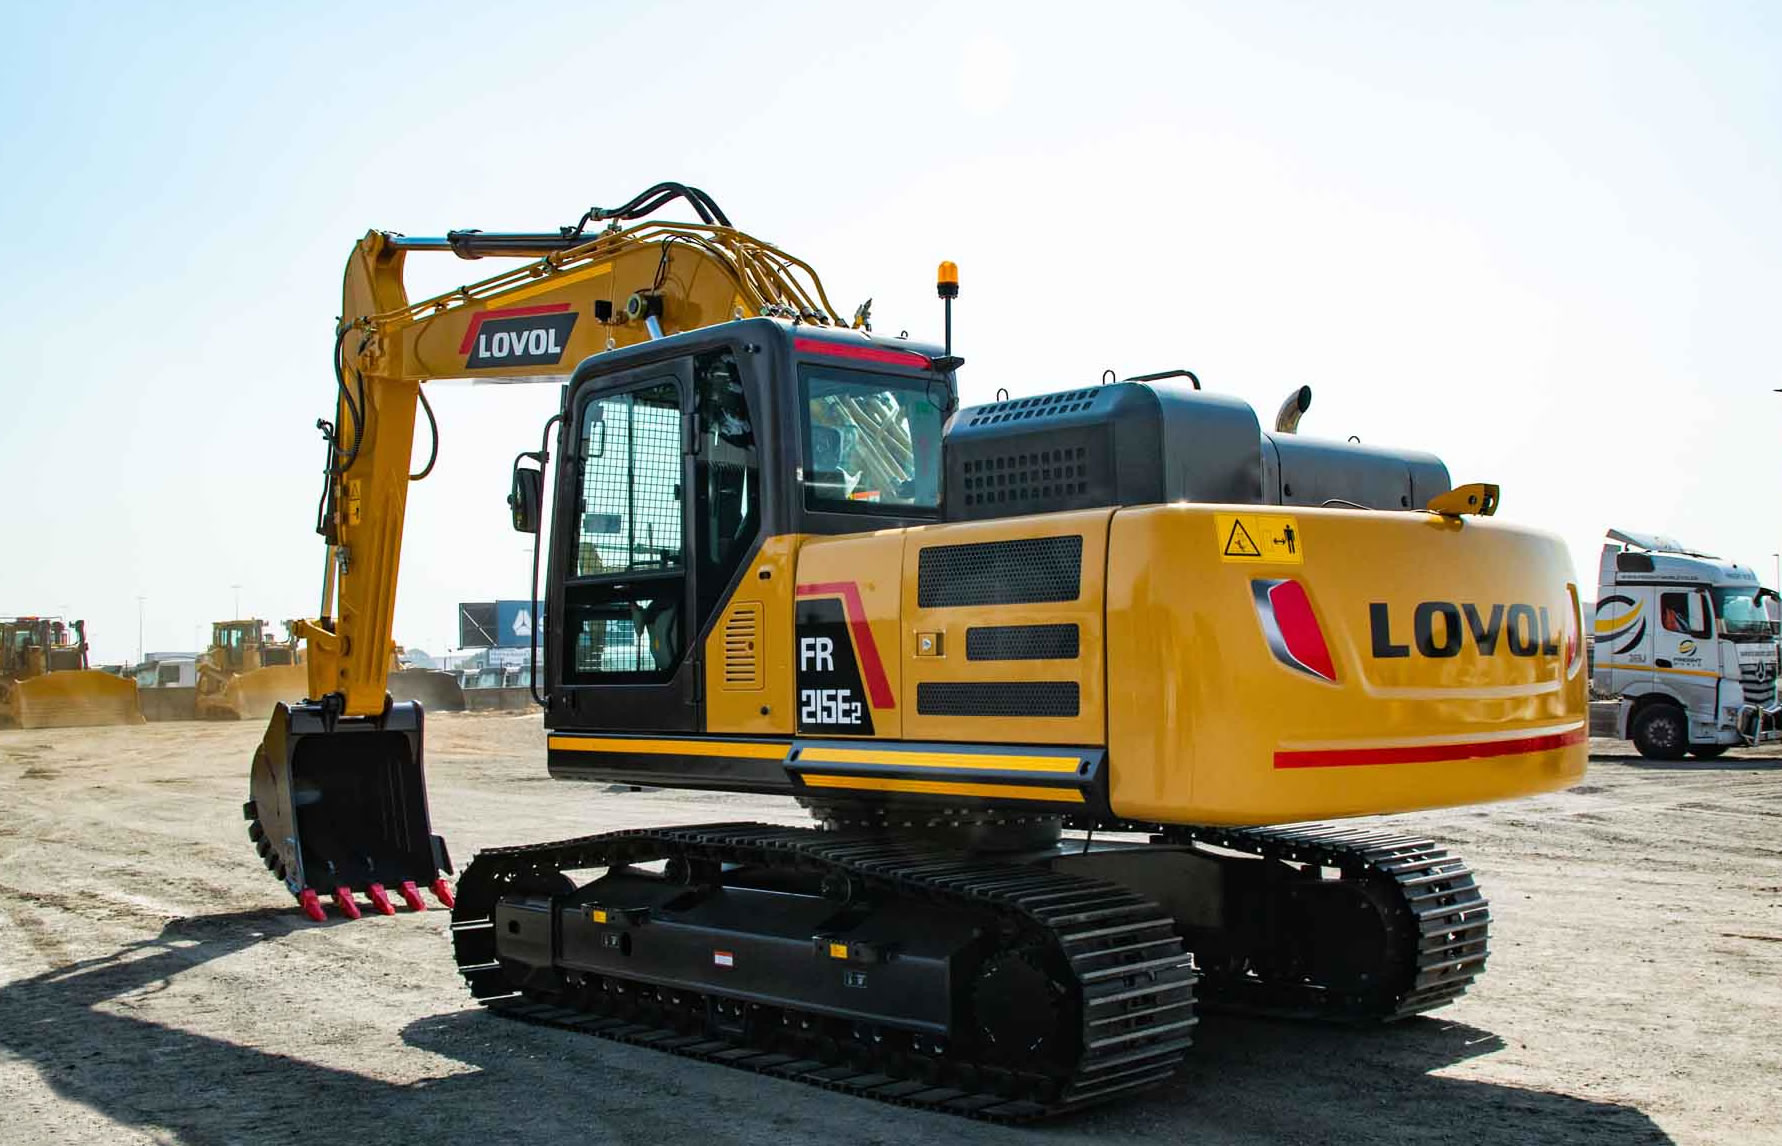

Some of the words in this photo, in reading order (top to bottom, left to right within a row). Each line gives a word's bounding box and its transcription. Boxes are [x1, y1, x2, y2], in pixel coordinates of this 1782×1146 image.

[478, 328, 561, 358] LOVOL
[1368, 601, 1560, 659] LOVOL
[800, 637, 834, 672] FR
[801, 689, 862, 725] 215E2
